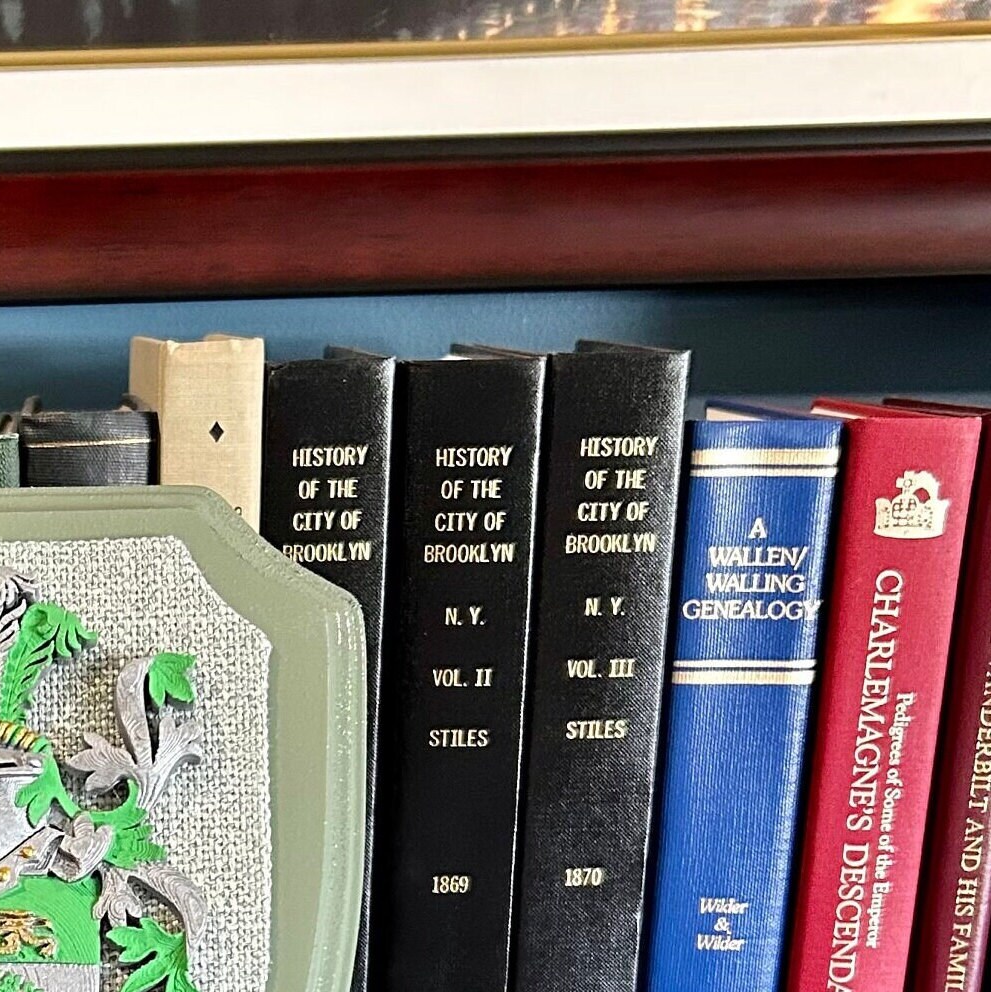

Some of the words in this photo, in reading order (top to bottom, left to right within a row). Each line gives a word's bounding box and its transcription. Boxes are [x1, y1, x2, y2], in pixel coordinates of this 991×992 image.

[292, 445, 369, 467] HISTORY
[580, 436, 659, 457] HISTORY
[435, 447, 512, 467] HISTORY
[298, 481, 320, 499] OF
[328, 479, 358, 498] THE
[441, 481, 464, 499] OF
[471, 480, 503, 499] THE
[585, 471, 607, 489] OF
[615, 470, 647, 490] THE
[292, 511, 334, 532] CITY
[341, 510, 362, 530] OF
[434, 513, 478, 532] CITY
[484, 511, 507, 531] OF
[577, 503, 620, 522] CITY
[626, 502, 650, 520] OF
[748, 518, 767, 539] A
[283, 541, 372, 563] BROOKLYN
[424, 543, 515, 563] BROOKLYN
[565, 533, 656, 554] BROOKLYN
[706, 573, 805, 593] WALLING
[445, 607, 462, 626] N.
[469, 606, 486, 626] Y.
[585, 598, 602, 616] N.
[610, 597, 626, 616] Y.
[682, 599, 823, 620] GENEALOGY
[433, 669, 468, 687] VOL.
[474, 669, 493, 687] II
[567, 660, 602, 678] VOL.
[608, 659, 636, 678] III
[846, 569, 904, 831] CHARLEMAGNE'S
[429, 729, 489, 747] STILES
[566, 721, 628, 740] STILES
[889, 692, 914, 766] Pedigrees
[886, 768, 903, 787] of
[880, 787, 901, 832] Some
[878, 835, 894, 854] of
[961, 818, 984, 872] AND
[564, 867, 604, 887] 1870
[875, 855, 893, 879] the
[432, 875, 470, 894] 1869
[700, 898, 748, 914] Wilder
[955, 877, 978, 917] HIS
[866, 881, 889, 949] Emperor
[714, 917, 732, 935] &
[698, 934, 745, 951] Wilder
